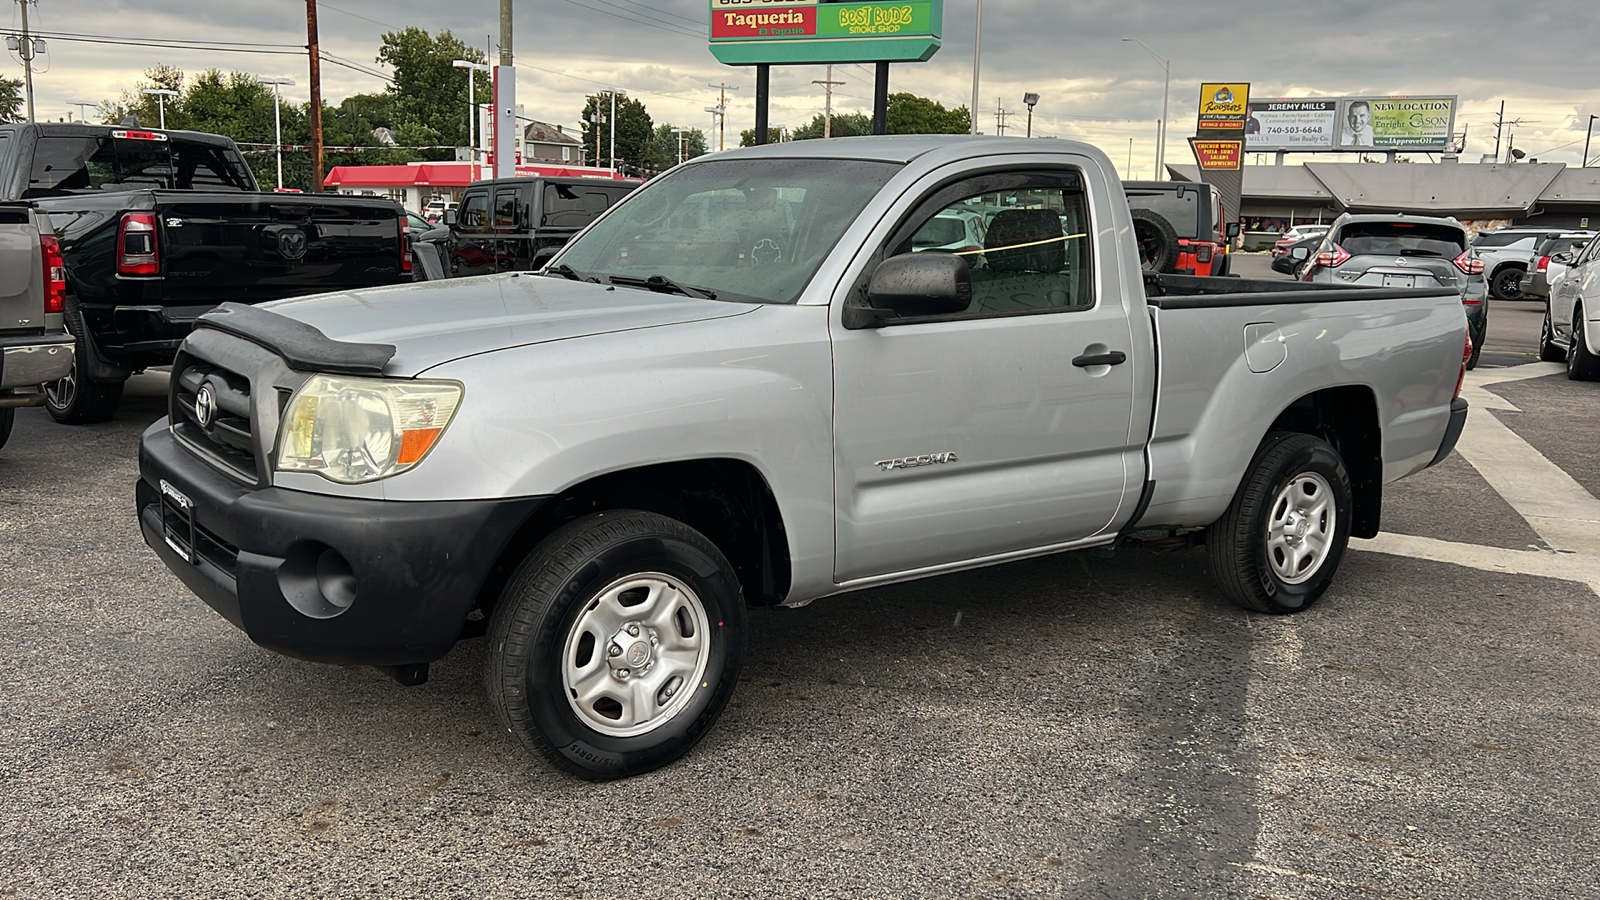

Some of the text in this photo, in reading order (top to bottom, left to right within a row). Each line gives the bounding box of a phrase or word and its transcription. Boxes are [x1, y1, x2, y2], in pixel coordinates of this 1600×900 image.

[849, 25, 900, 34] SMOKE SHOP
[1205, 101, 1242, 113] Roosters
[1301, 102, 1326, 110] MILLS
[1374, 102, 1450, 111] NEW LOCATION
[1375, 121, 1405, 129] Enright
[1302, 135, 1319, 143] Realty
[874, 451, 959, 471] TACOMA
